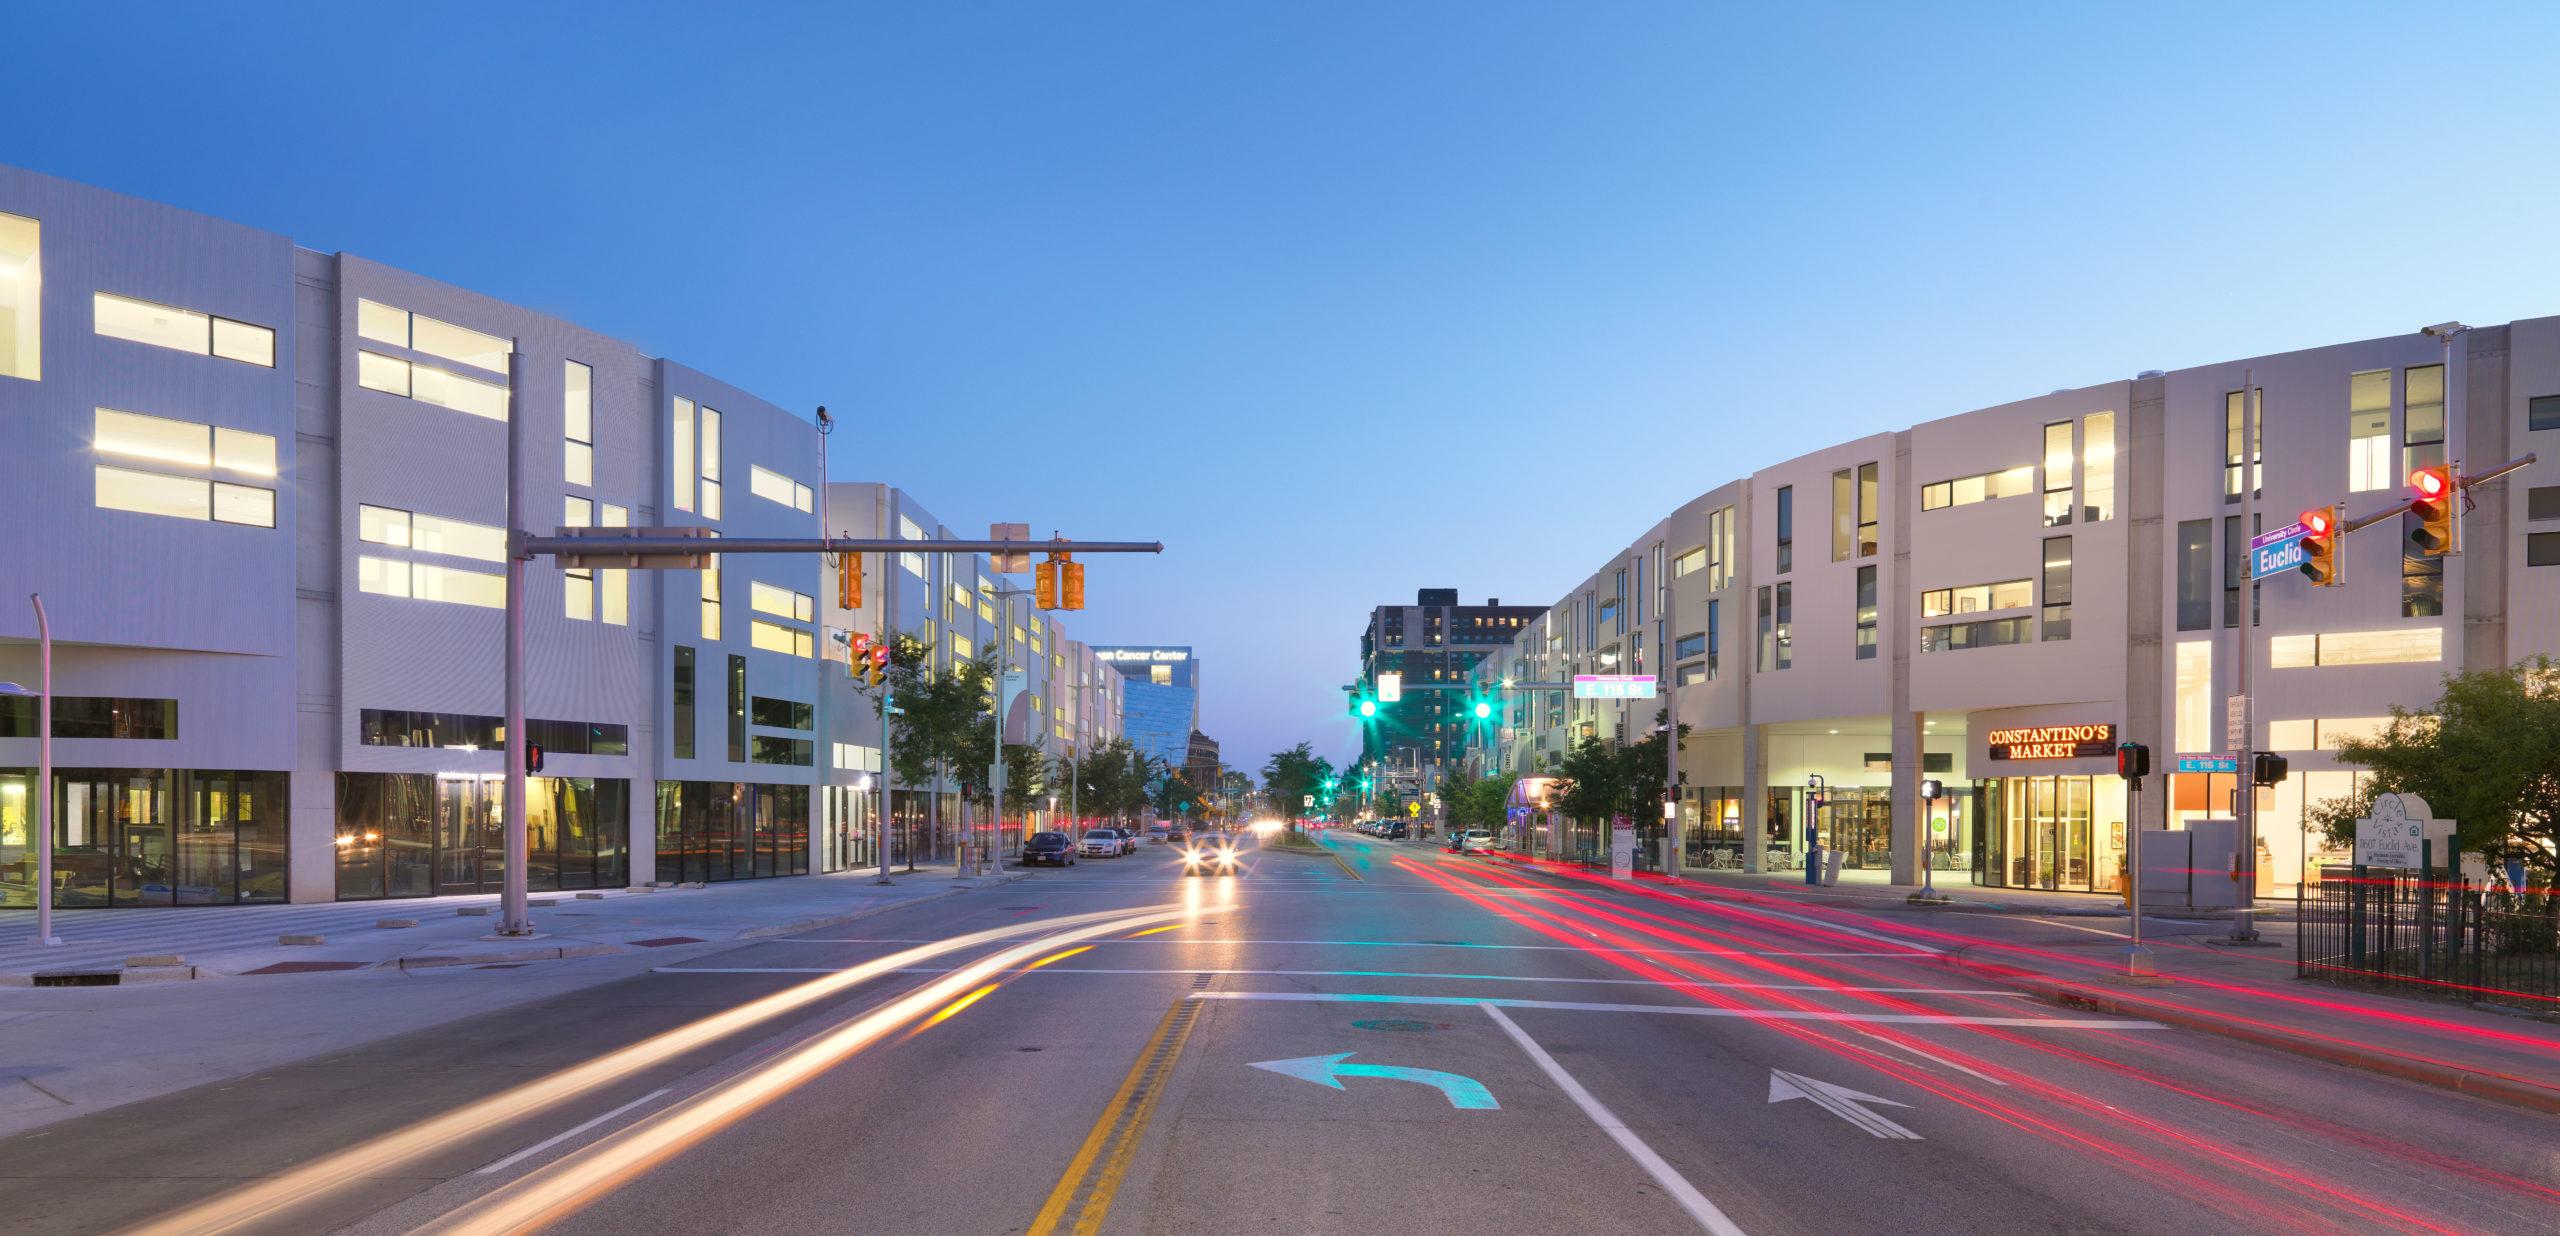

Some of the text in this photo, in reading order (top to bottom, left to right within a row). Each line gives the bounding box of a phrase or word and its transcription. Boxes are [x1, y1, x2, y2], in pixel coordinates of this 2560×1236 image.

[2262, 530, 2287, 544] University
[2260, 540, 2302, 573] Euclid
[1116, 650, 1151, 660] Cancer
[1153, 650, 1188, 660] Center
[1603, 683, 1625, 696] 115
[1627, 683, 1645, 696] St
[1989, 725, 2109, 744] CONSTANTINO'S
[2009, 742, 2076, 759] MARKET
[2373, 800, 2404, 817] Circle
[2373, 818, 2403, 838] Vistas
[2379, 839, 2400, 851] Euclid
[2403, 841, 2420, 852] Ave.
